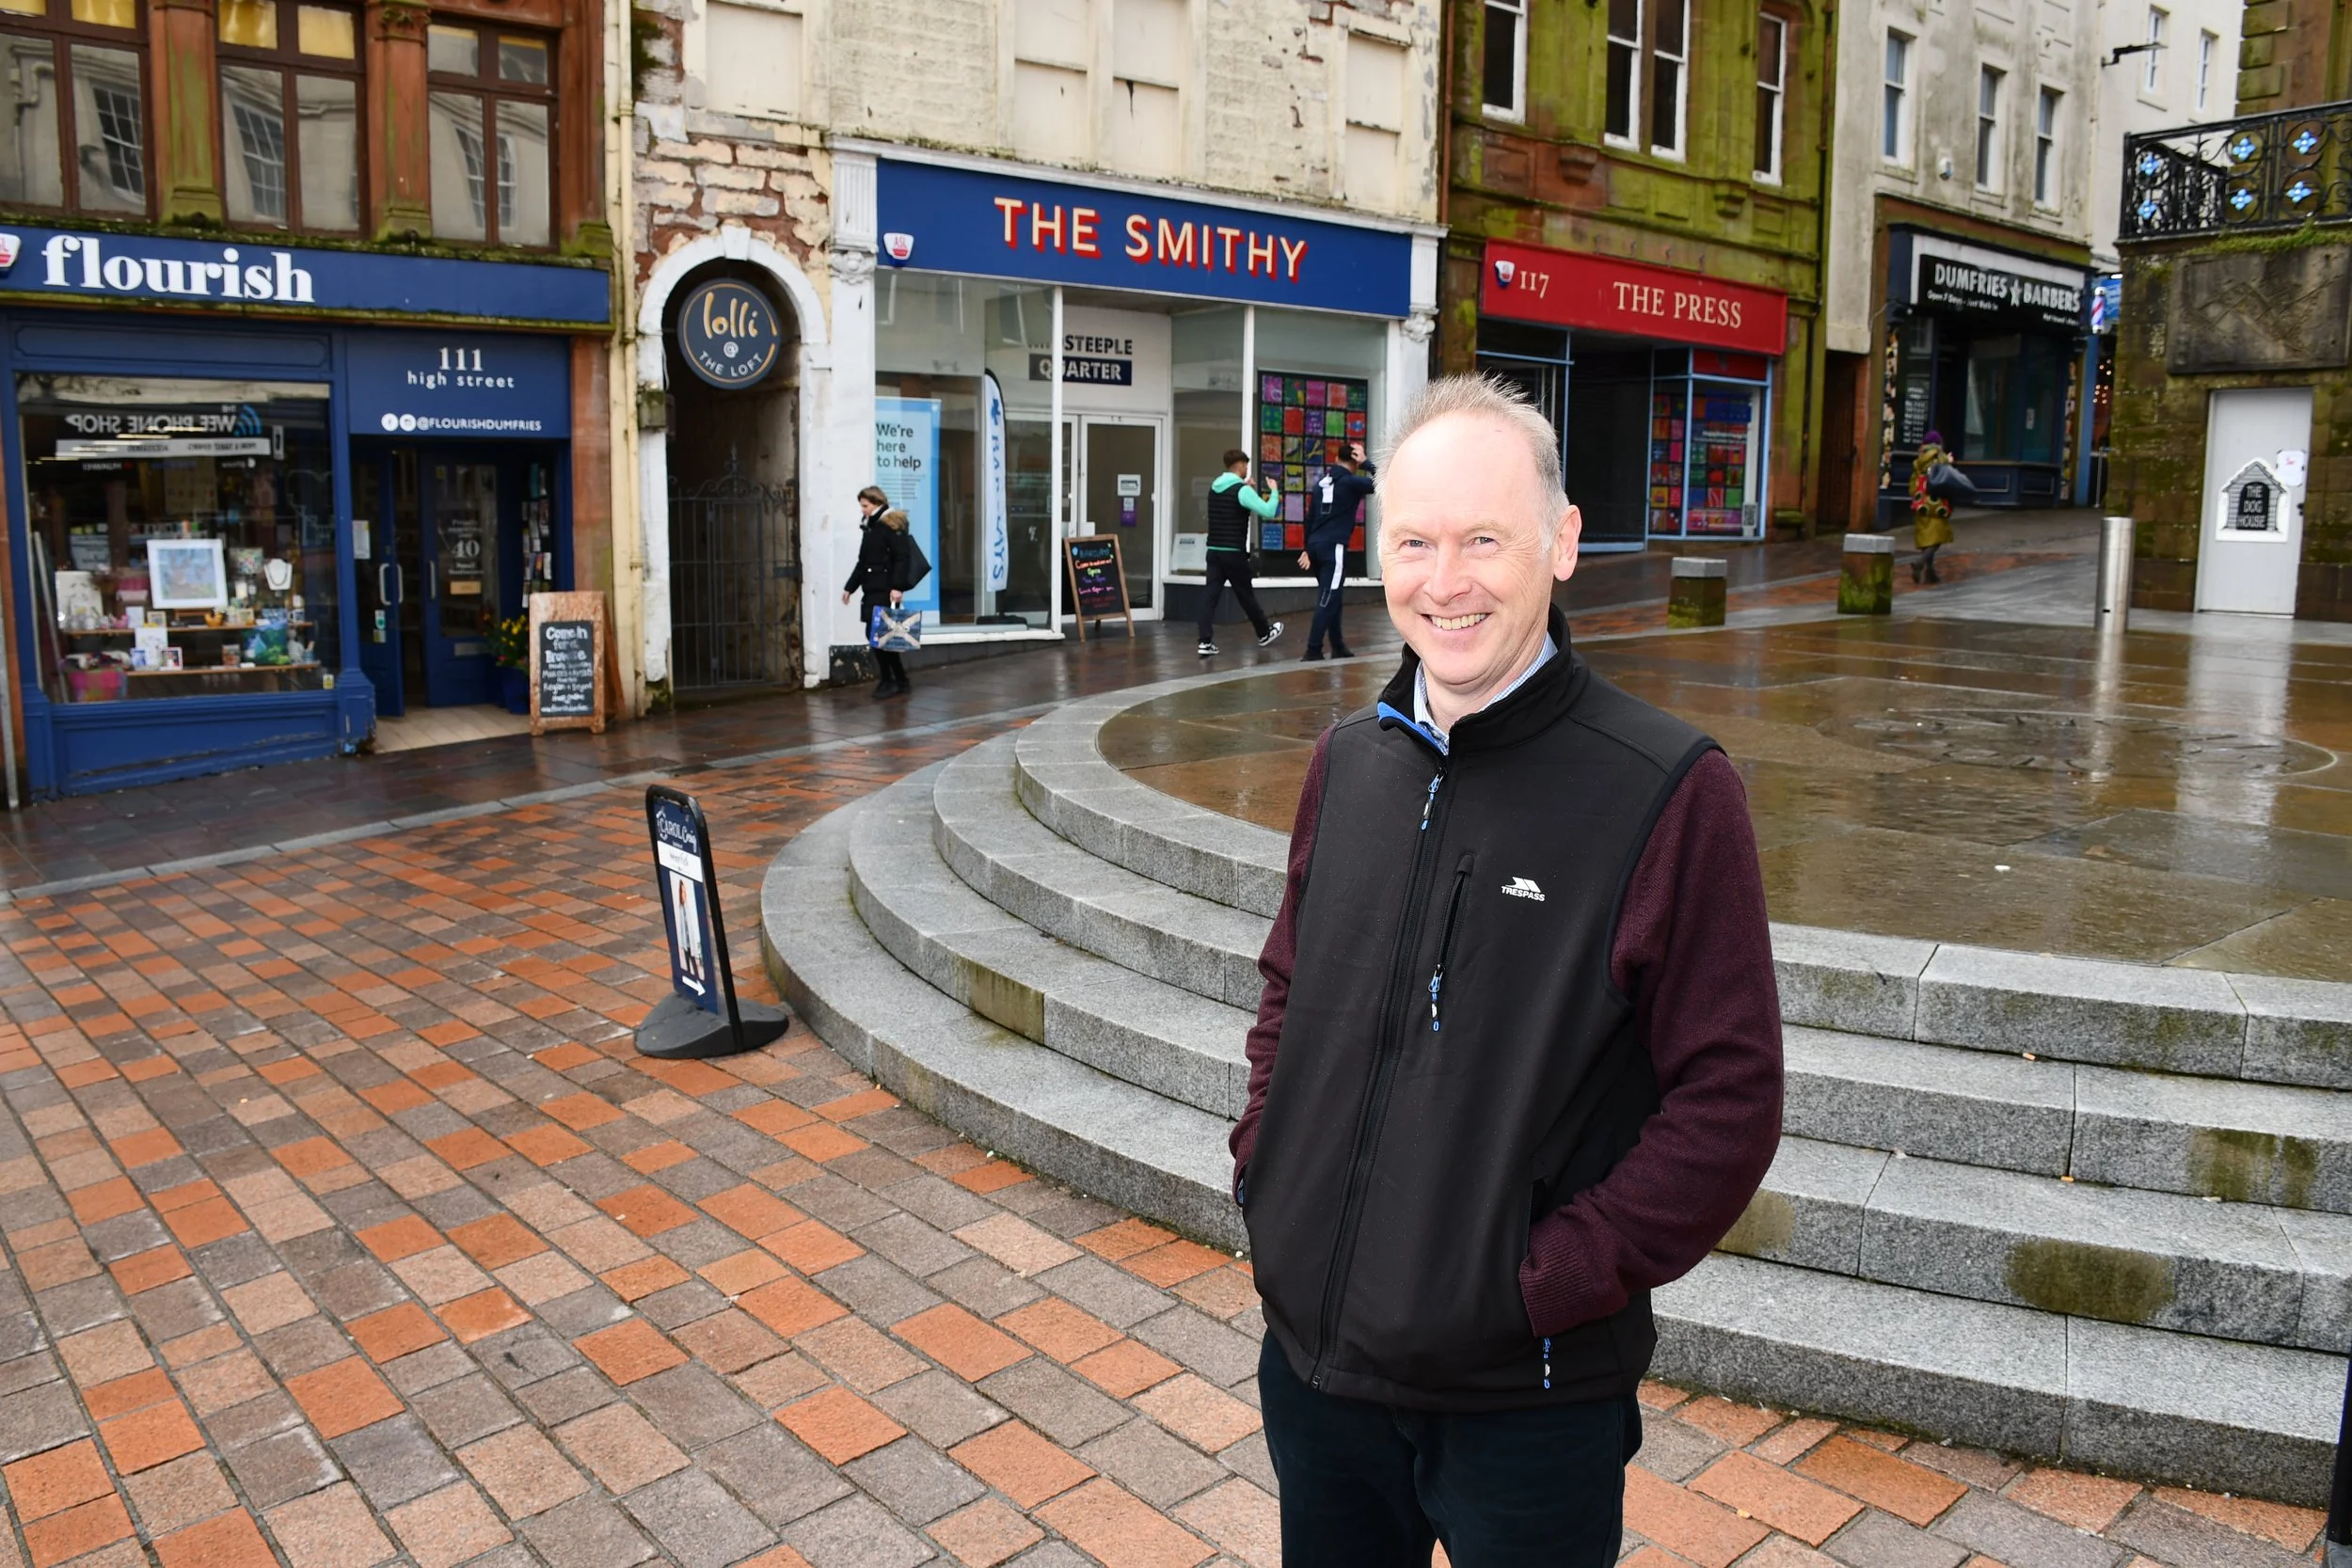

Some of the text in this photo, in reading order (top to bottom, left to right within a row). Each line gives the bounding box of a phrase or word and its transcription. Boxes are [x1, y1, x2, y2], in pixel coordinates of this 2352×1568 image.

[994, 197, 1307, 283] THE SMITHY
[41, 235, 314, 303] flourish
[1519, 271, 1549, 298] 117
[1934, 263, 2008, 299] DUMFRIES
[2023, 282, 2080, 313] BARBERS
[703, 292, 758, 340] lolli
[1613, 281, 1741, 329] THE PRESS
[439, 347, 484, 372] 111
[699, 350, 763, 377] THE LOFT
[407, 370, 515, 389] high street
[417, 417, 542, 432] @FLOURISHDUMFRIES
[876, 422, 914, 438] We're
[877, 438, 906, 453] here
[877, 455, 921, 471] to help
[2247, 485, 2263, 498] THE
[452, 540, 480, 558] 40
[1501, 886, 1546, 902] TRESPASS
